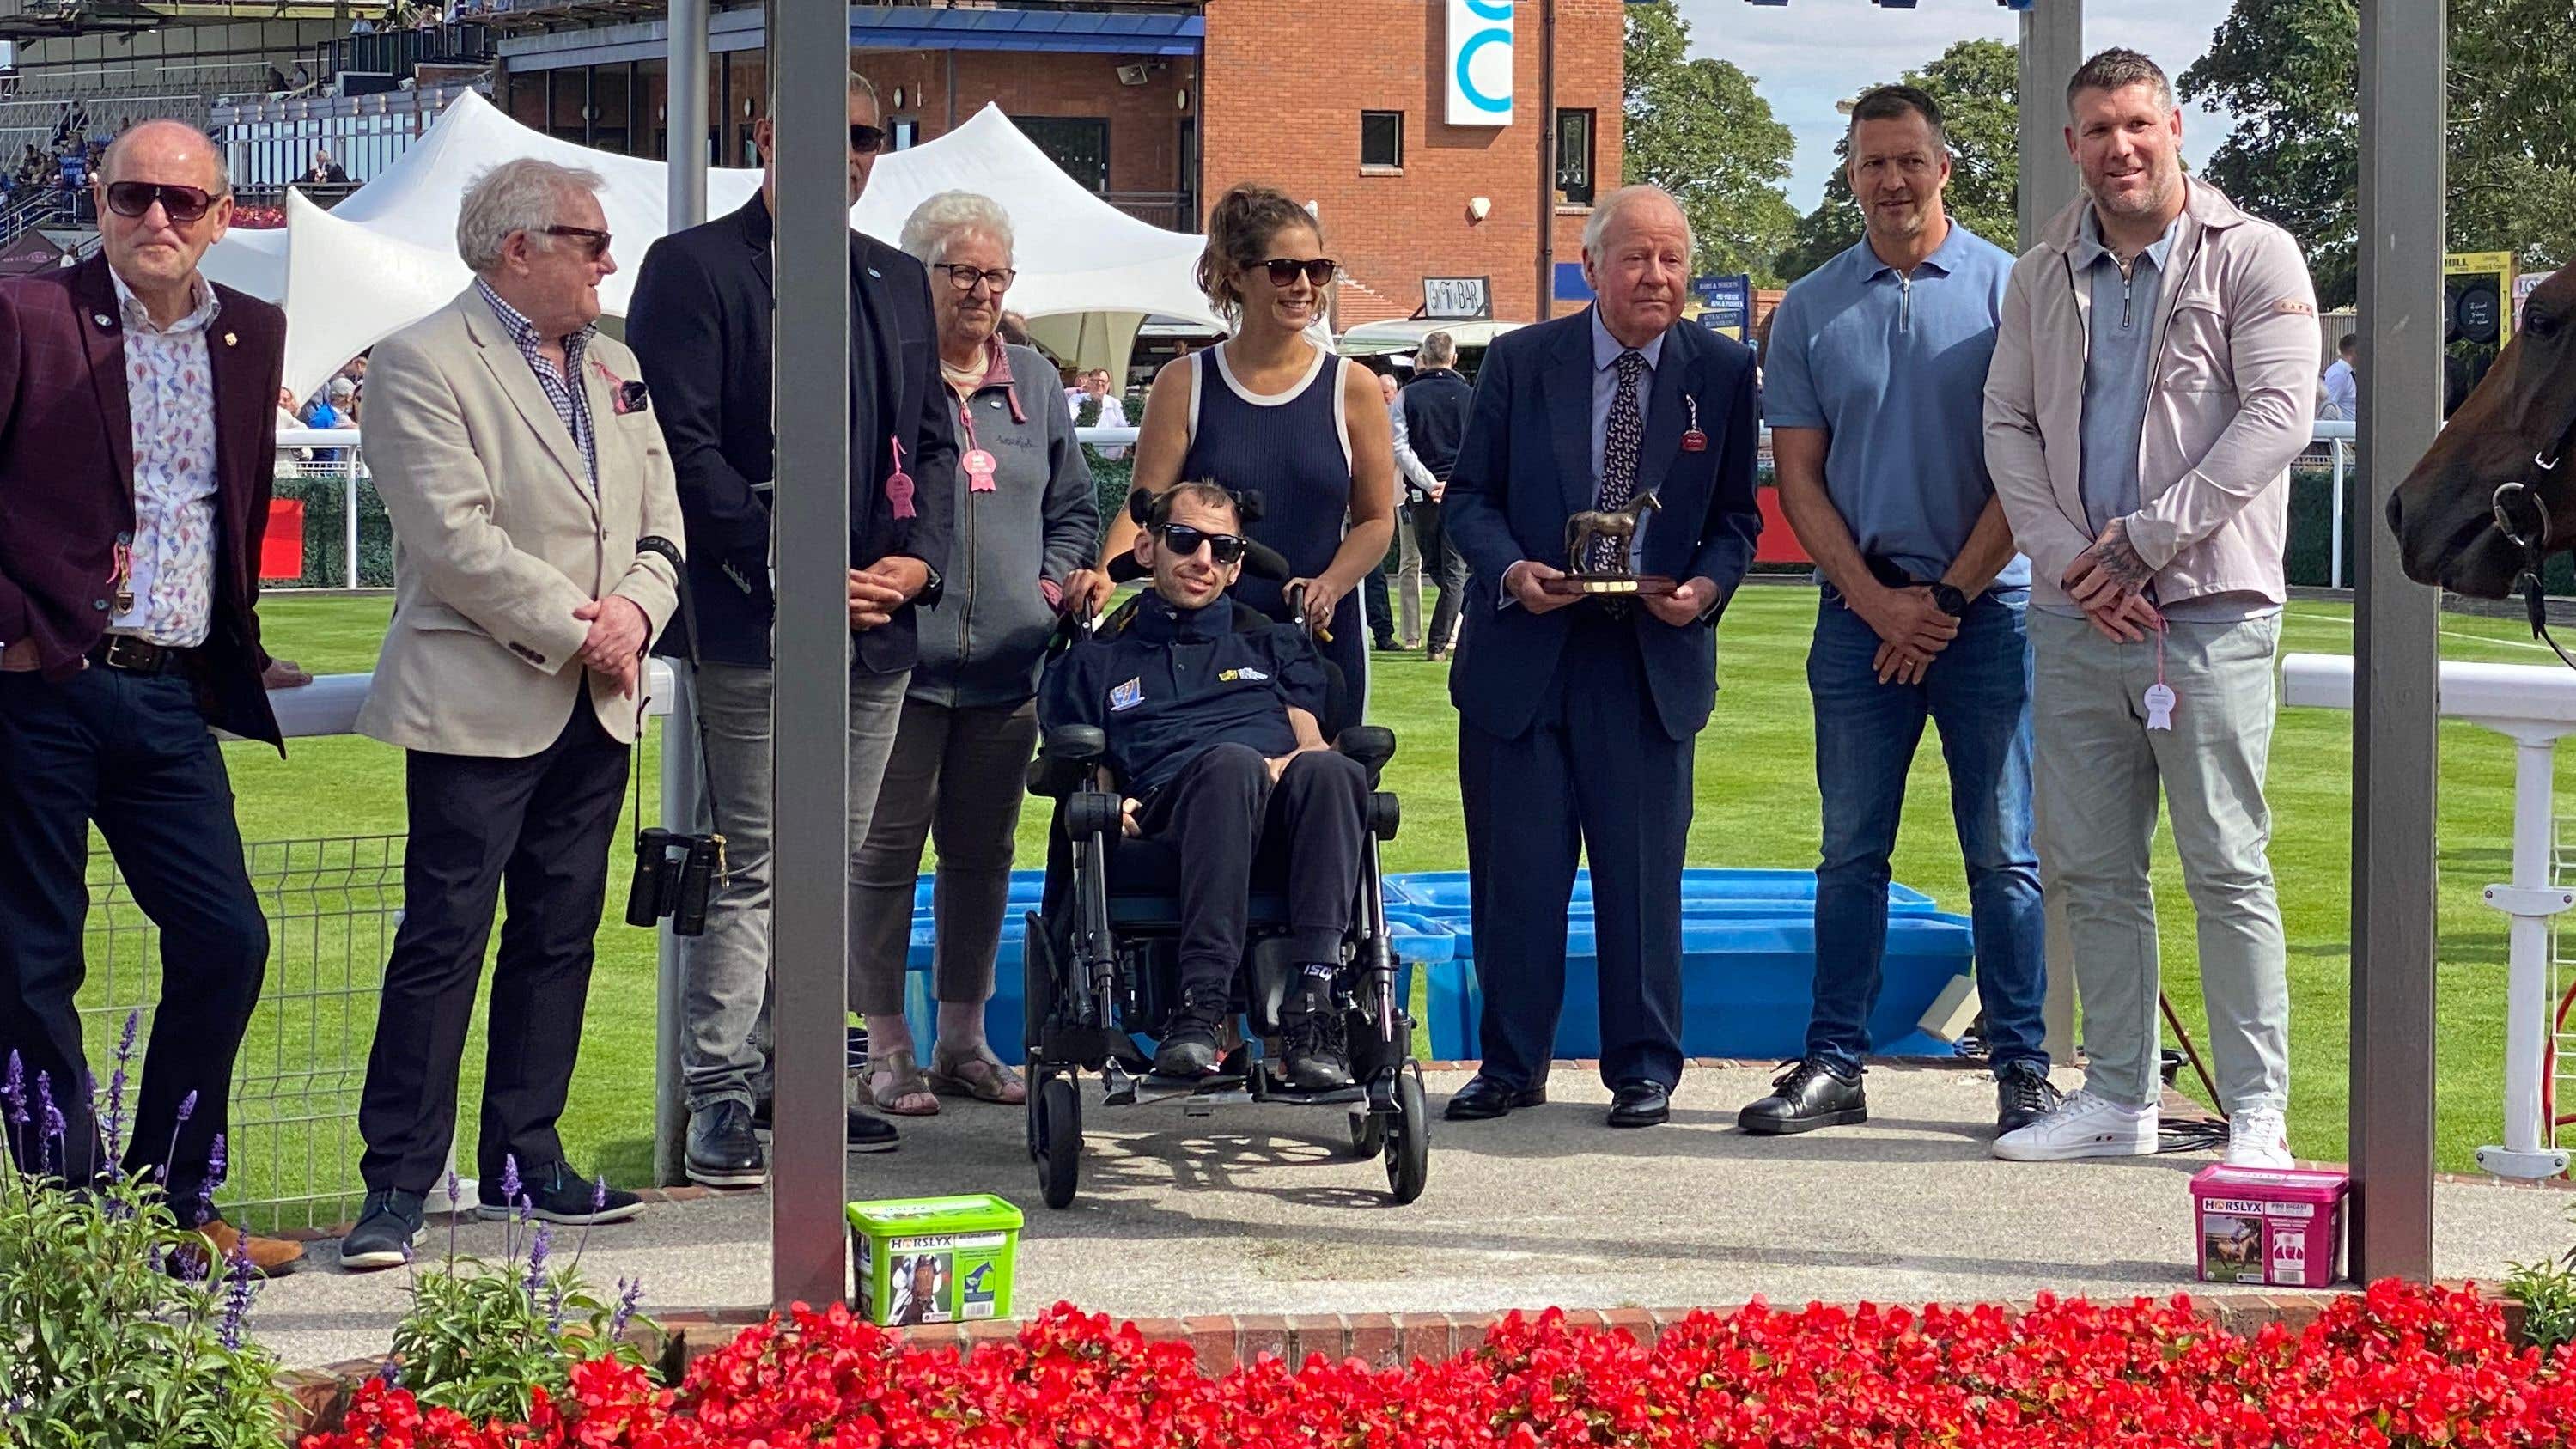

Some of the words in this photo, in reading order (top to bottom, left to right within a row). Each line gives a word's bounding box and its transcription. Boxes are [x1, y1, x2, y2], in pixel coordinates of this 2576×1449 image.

[1457, 281, 1479, 309] BAR
[2205, 1200, 2262, 1212] HORSLYX
[892, 1235, 952, 1249] HORSLYX
